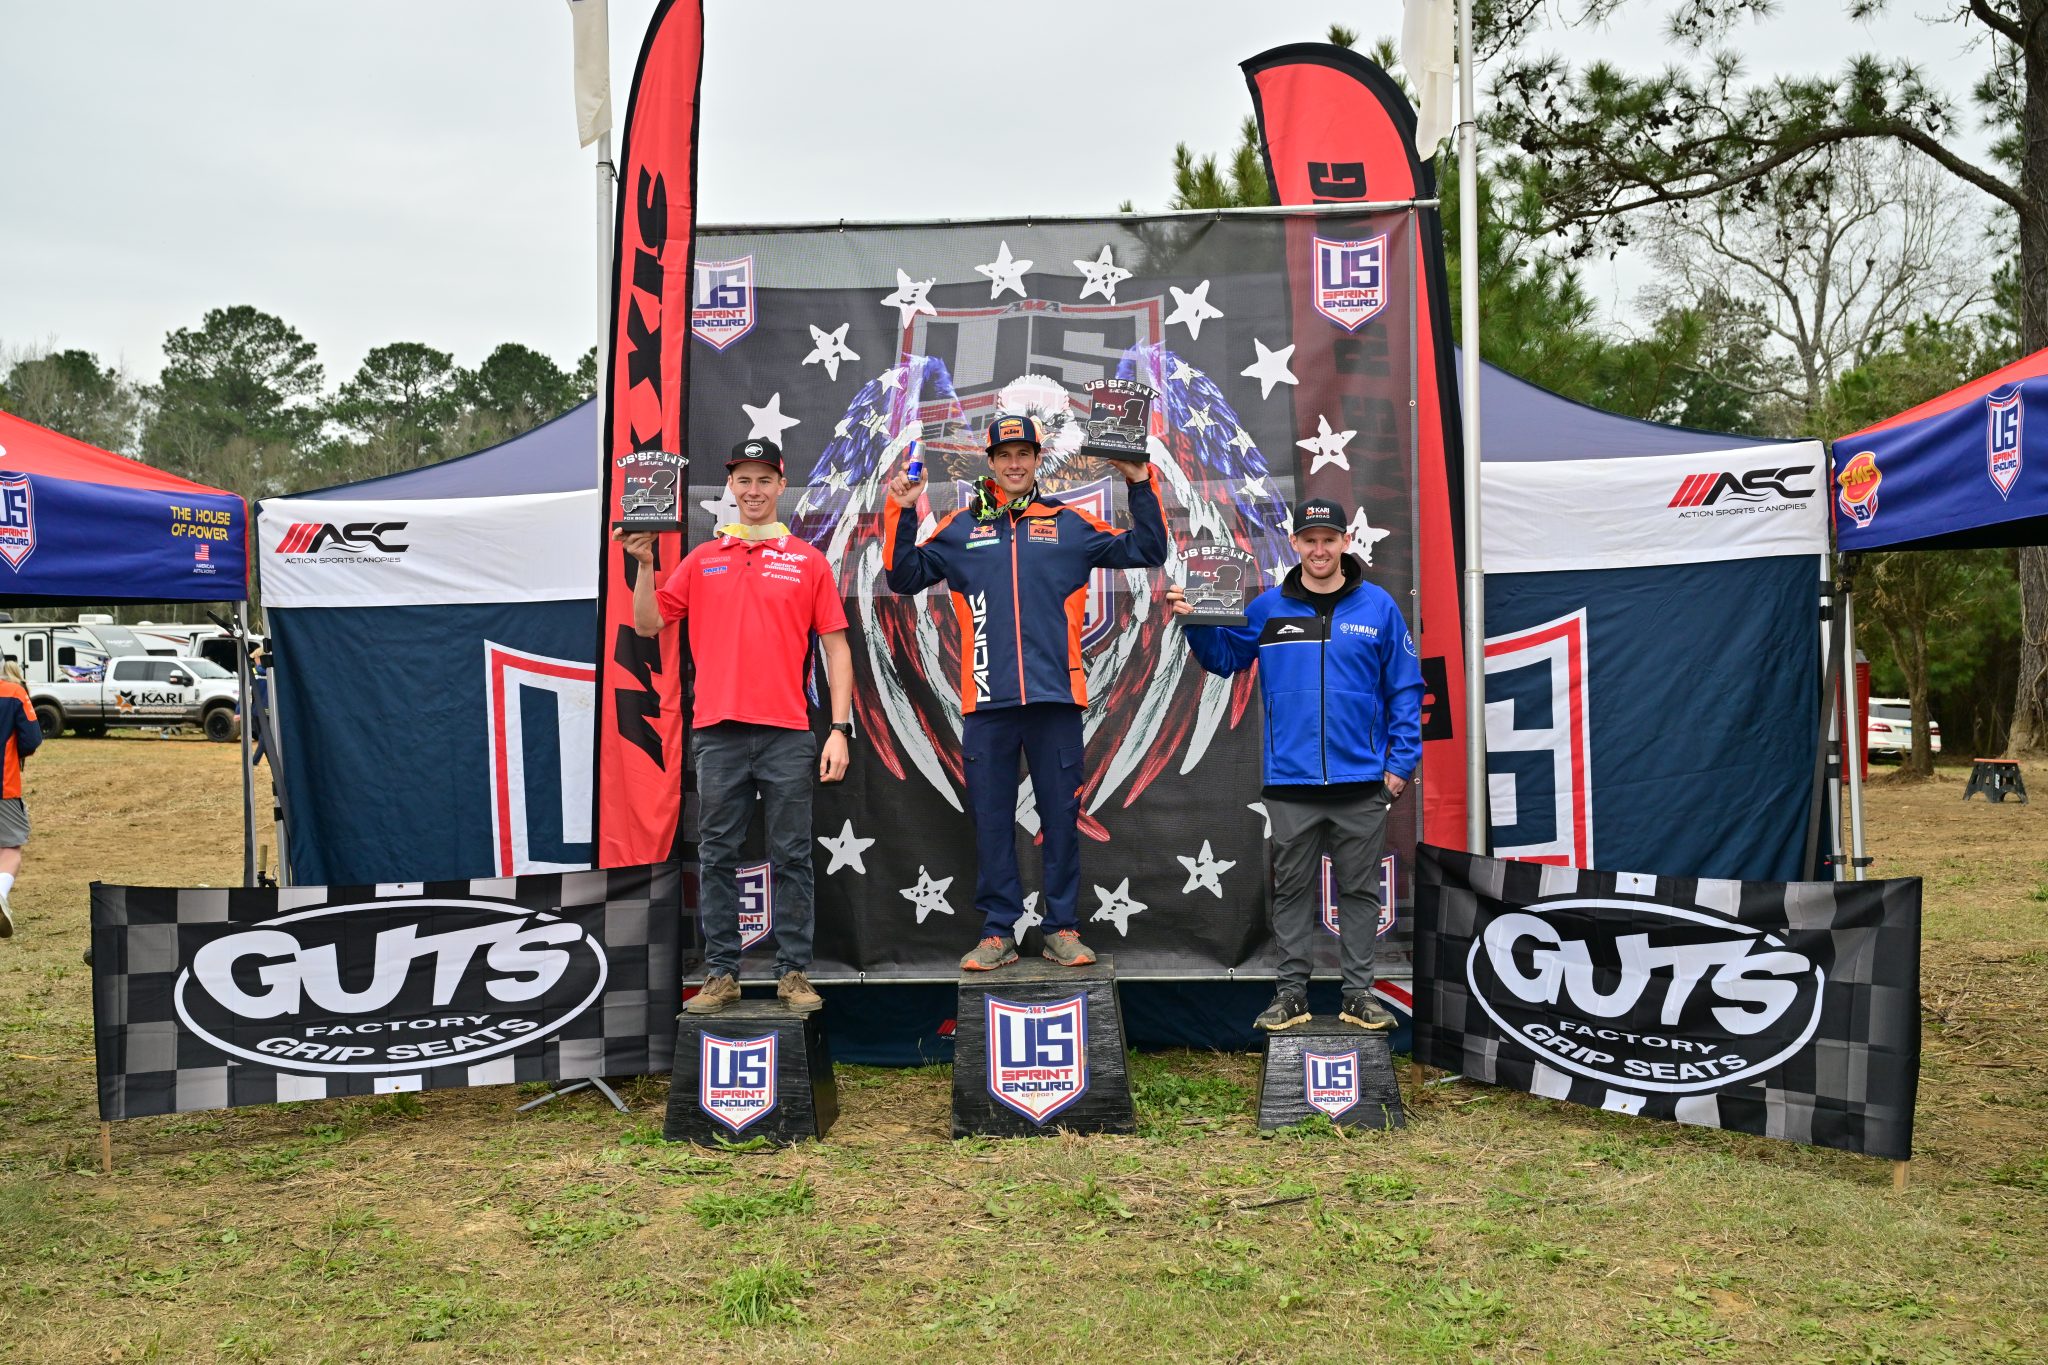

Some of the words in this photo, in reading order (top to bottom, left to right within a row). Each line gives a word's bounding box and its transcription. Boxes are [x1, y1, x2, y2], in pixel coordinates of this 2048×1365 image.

[1321, 245, 1379, 289] US
[693, 266, 746, 309] US
[1323, 290, 1378, 299] SPRINT
[1323, 299, 1378, 308] ENDURO
[692, 310, 746, 319] SPRINT
[693, 319, 746, 327] ENDURO
[1084, 380, 1105, 392] US
[1107, 379, 1159, 399] SPRINT
[1119, 398, 1145, 427] 1
[1992, 403, 2018, 453] US
[617, 453, 636, 467] US
[637, 451, 688, 468] SPRINT
[1993, 450, 2017, 464] SPRINT
[1993, 460, 2017, 472] ENDURO
[647, 469, 676, 497] 2
[1841, 464, 1874, 486] FMF
[1700, 465, 1816, 506] ASC
[169, 506, 192, 521] THE
[195, 508, 231, 525] HOUSE
[1678, 510, 1714, 518] ACTION
[1716, 507, 1756, 516] SPORTS
[1758, 503, 1808, 513] CANOPIES
[171, 523, 188, 537] OF
[187, 525, 229, 541] POWER
[306, 522, 409, 553] ASC
[1033, 527, 1053, 535] KTM
[356, 556, 401, 564] CANOPIES
[1178, 548, 1199, 560] US
[1201, 546, 1255, 562] SPRINT
[771, 573, 801, 583] HONDA
[1349, 624, 1378, 636] YAMAHA
[968, 589, 991, 702] RACING
[141, 692, 183, 704] KARI
[736, 873, 764, 914] S
[192, 912, 585, 1020] GUTS
[1483, 911, 1811, 1036] GUTS
[305, 1013, 492, 1037] FACTORY
[255, 1036, 369, 1063] GRIP
[386, 1016, 540, 1061] SEATS
[999, 1012, 1074, 1068] US
[1558, 1020, 1719, 1056] FACTORY
[1522, 1023, 1615, 1067] GRIP
[1623, 1053, 1748, 1081] SEATS
[710, 1046, 767, 1088] US
[1001, 1068, 1074, 1081] SPRINT
[1311, 1059, 1353, 1089] US
[711, 1090, 765, 1098] SPRINT
[1002, 1081, 1074, 1092] ENDURO
[711, 1099, 765, 1107] ENDURO
